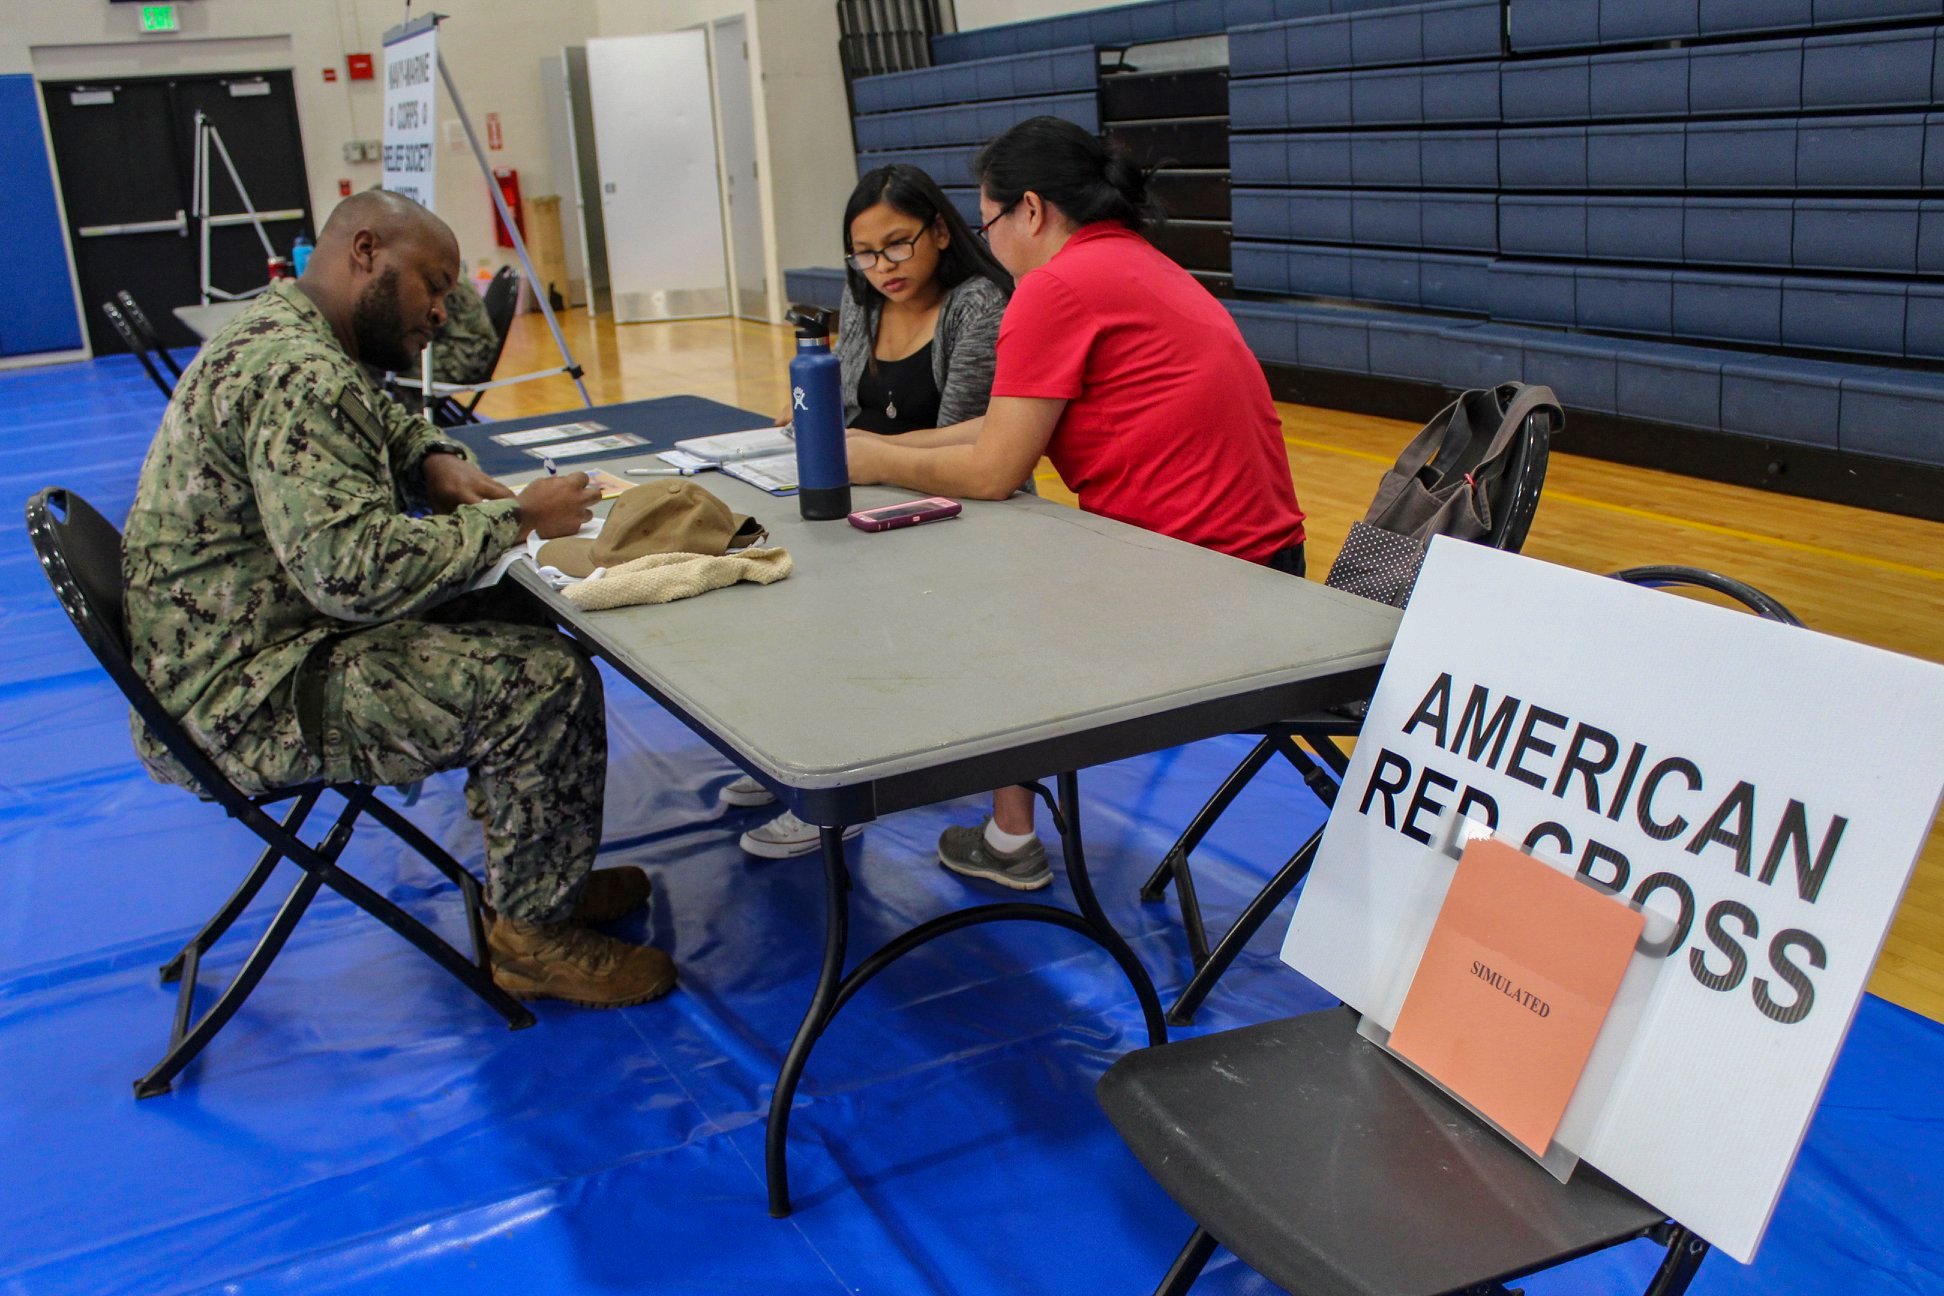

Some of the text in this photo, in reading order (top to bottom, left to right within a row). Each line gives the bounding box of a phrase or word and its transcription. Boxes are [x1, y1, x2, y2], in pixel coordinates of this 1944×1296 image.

[144, 6, 174, 29] EXIT
[398, 100, 419, 130] CORPS
[1359, 747, 1499, 860] RED
[1402, 672, 1848, 904] AMERICAN
[1470, 960, 1550, 1018] SIMULATED
